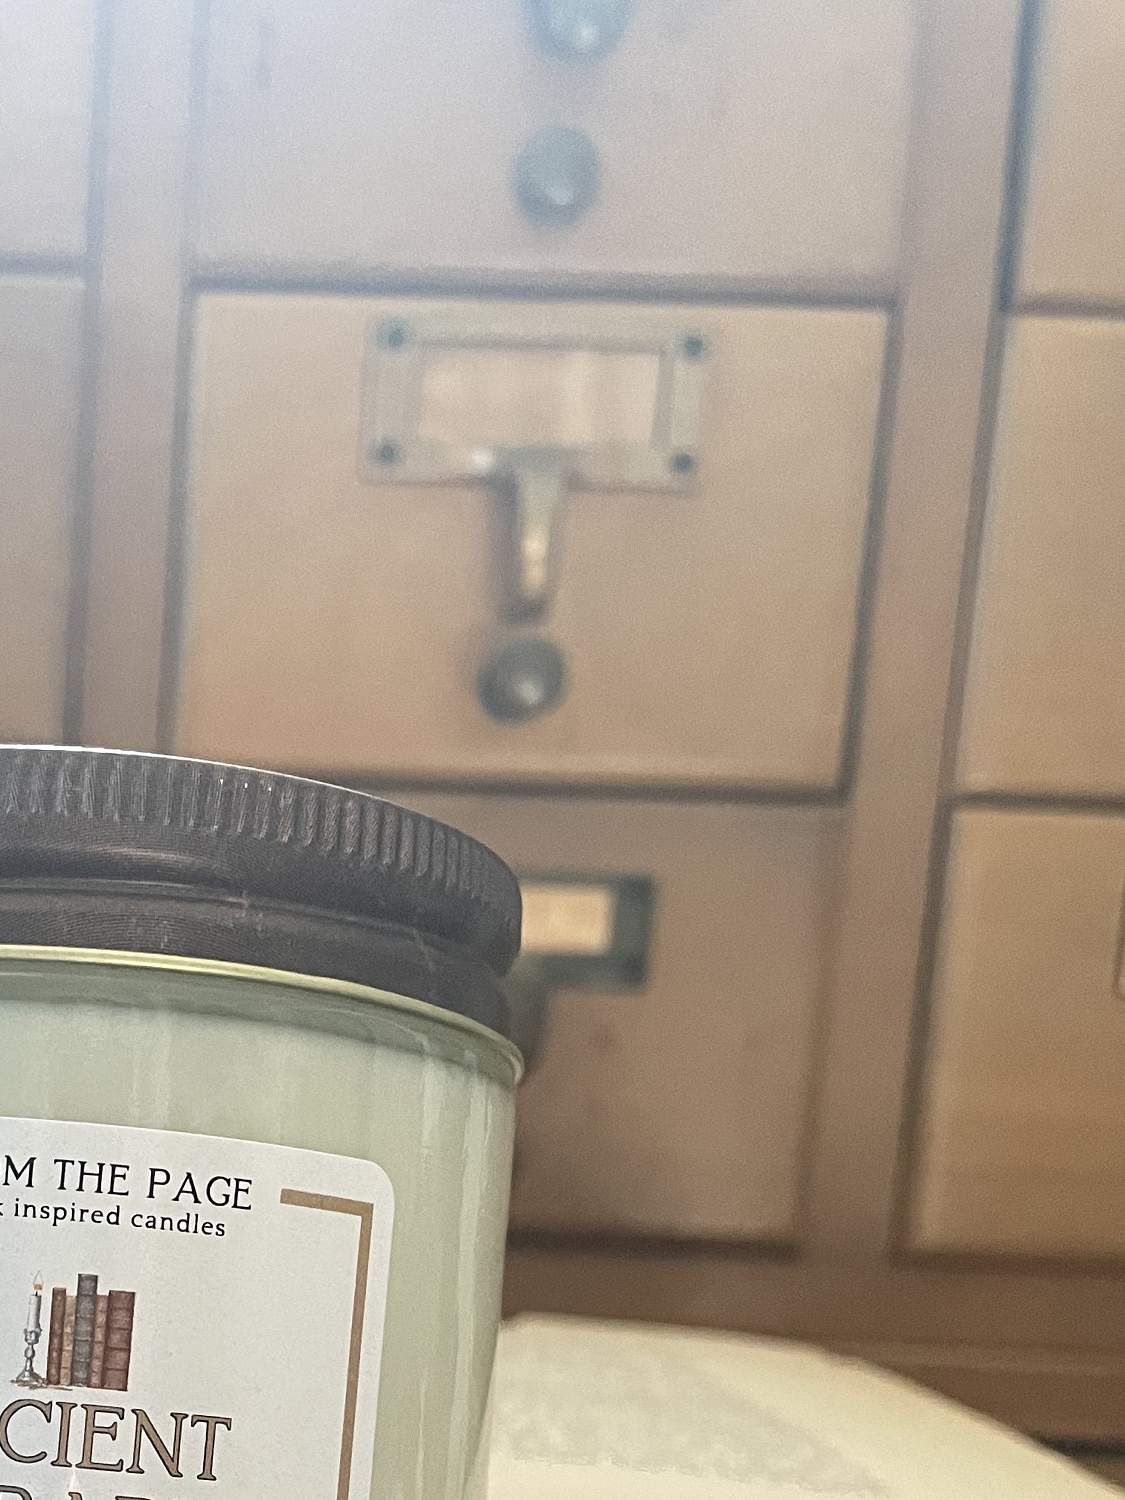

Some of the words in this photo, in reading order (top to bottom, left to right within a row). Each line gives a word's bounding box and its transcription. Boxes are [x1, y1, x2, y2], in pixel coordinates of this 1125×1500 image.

[54, 1159, 130, 1196] THE
[146, 1168, 252, 1210] PAGE
[13, 1198, 120, 1227] inspired
[131, 1212, 225, 1236] candles
